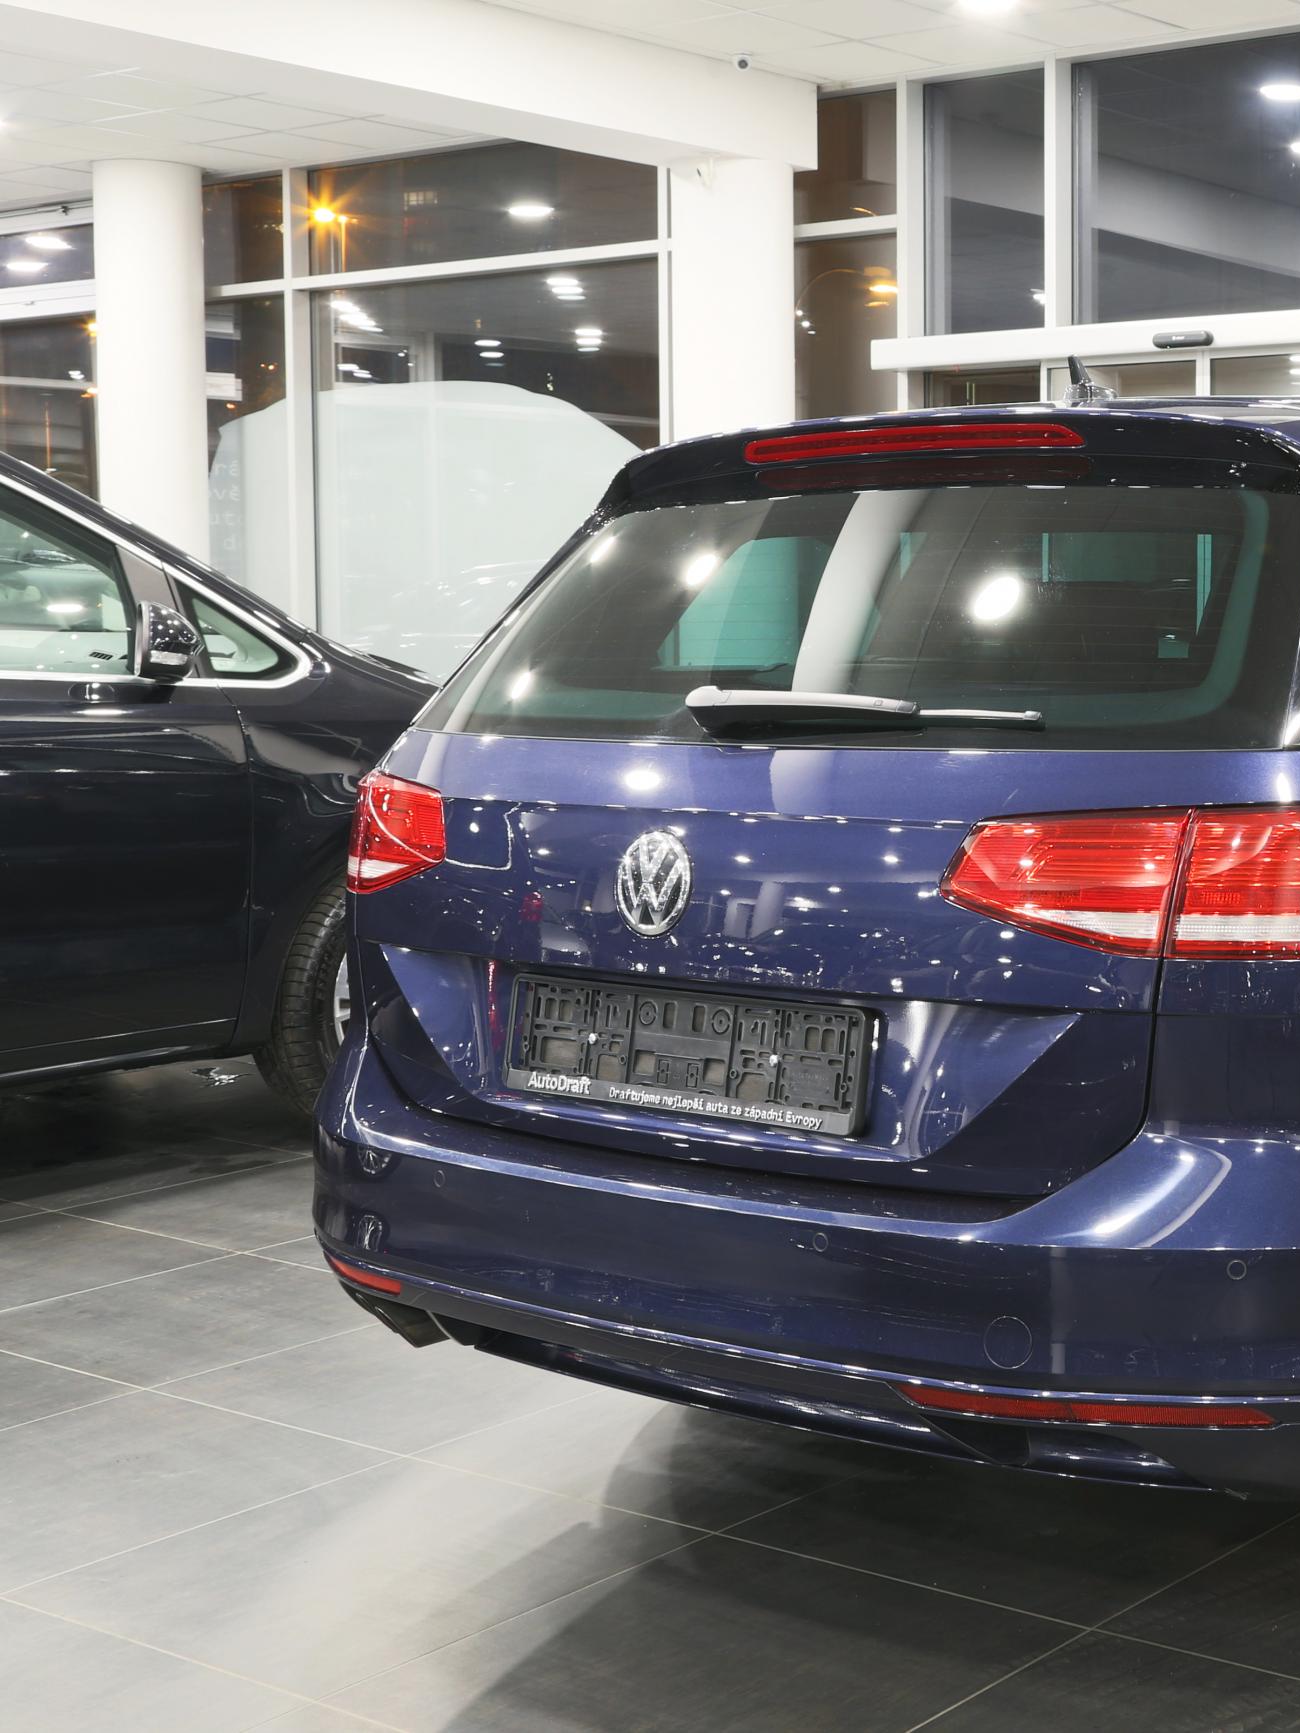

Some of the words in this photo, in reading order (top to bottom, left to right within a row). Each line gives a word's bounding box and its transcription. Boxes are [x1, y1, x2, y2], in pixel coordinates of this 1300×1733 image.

[527, 1072, 592, 1095] AutoDraft
[608, 1086, 661, 1104] Draftujeme
[662, 1095, 704, 1111] nejlepší
[705, 1102, 729, 1114] auta
[730, 1105, 742, 1116] ze
[744, 1105, 784, 1121] západní
[785, 1111, 823, 1130] Evropy
